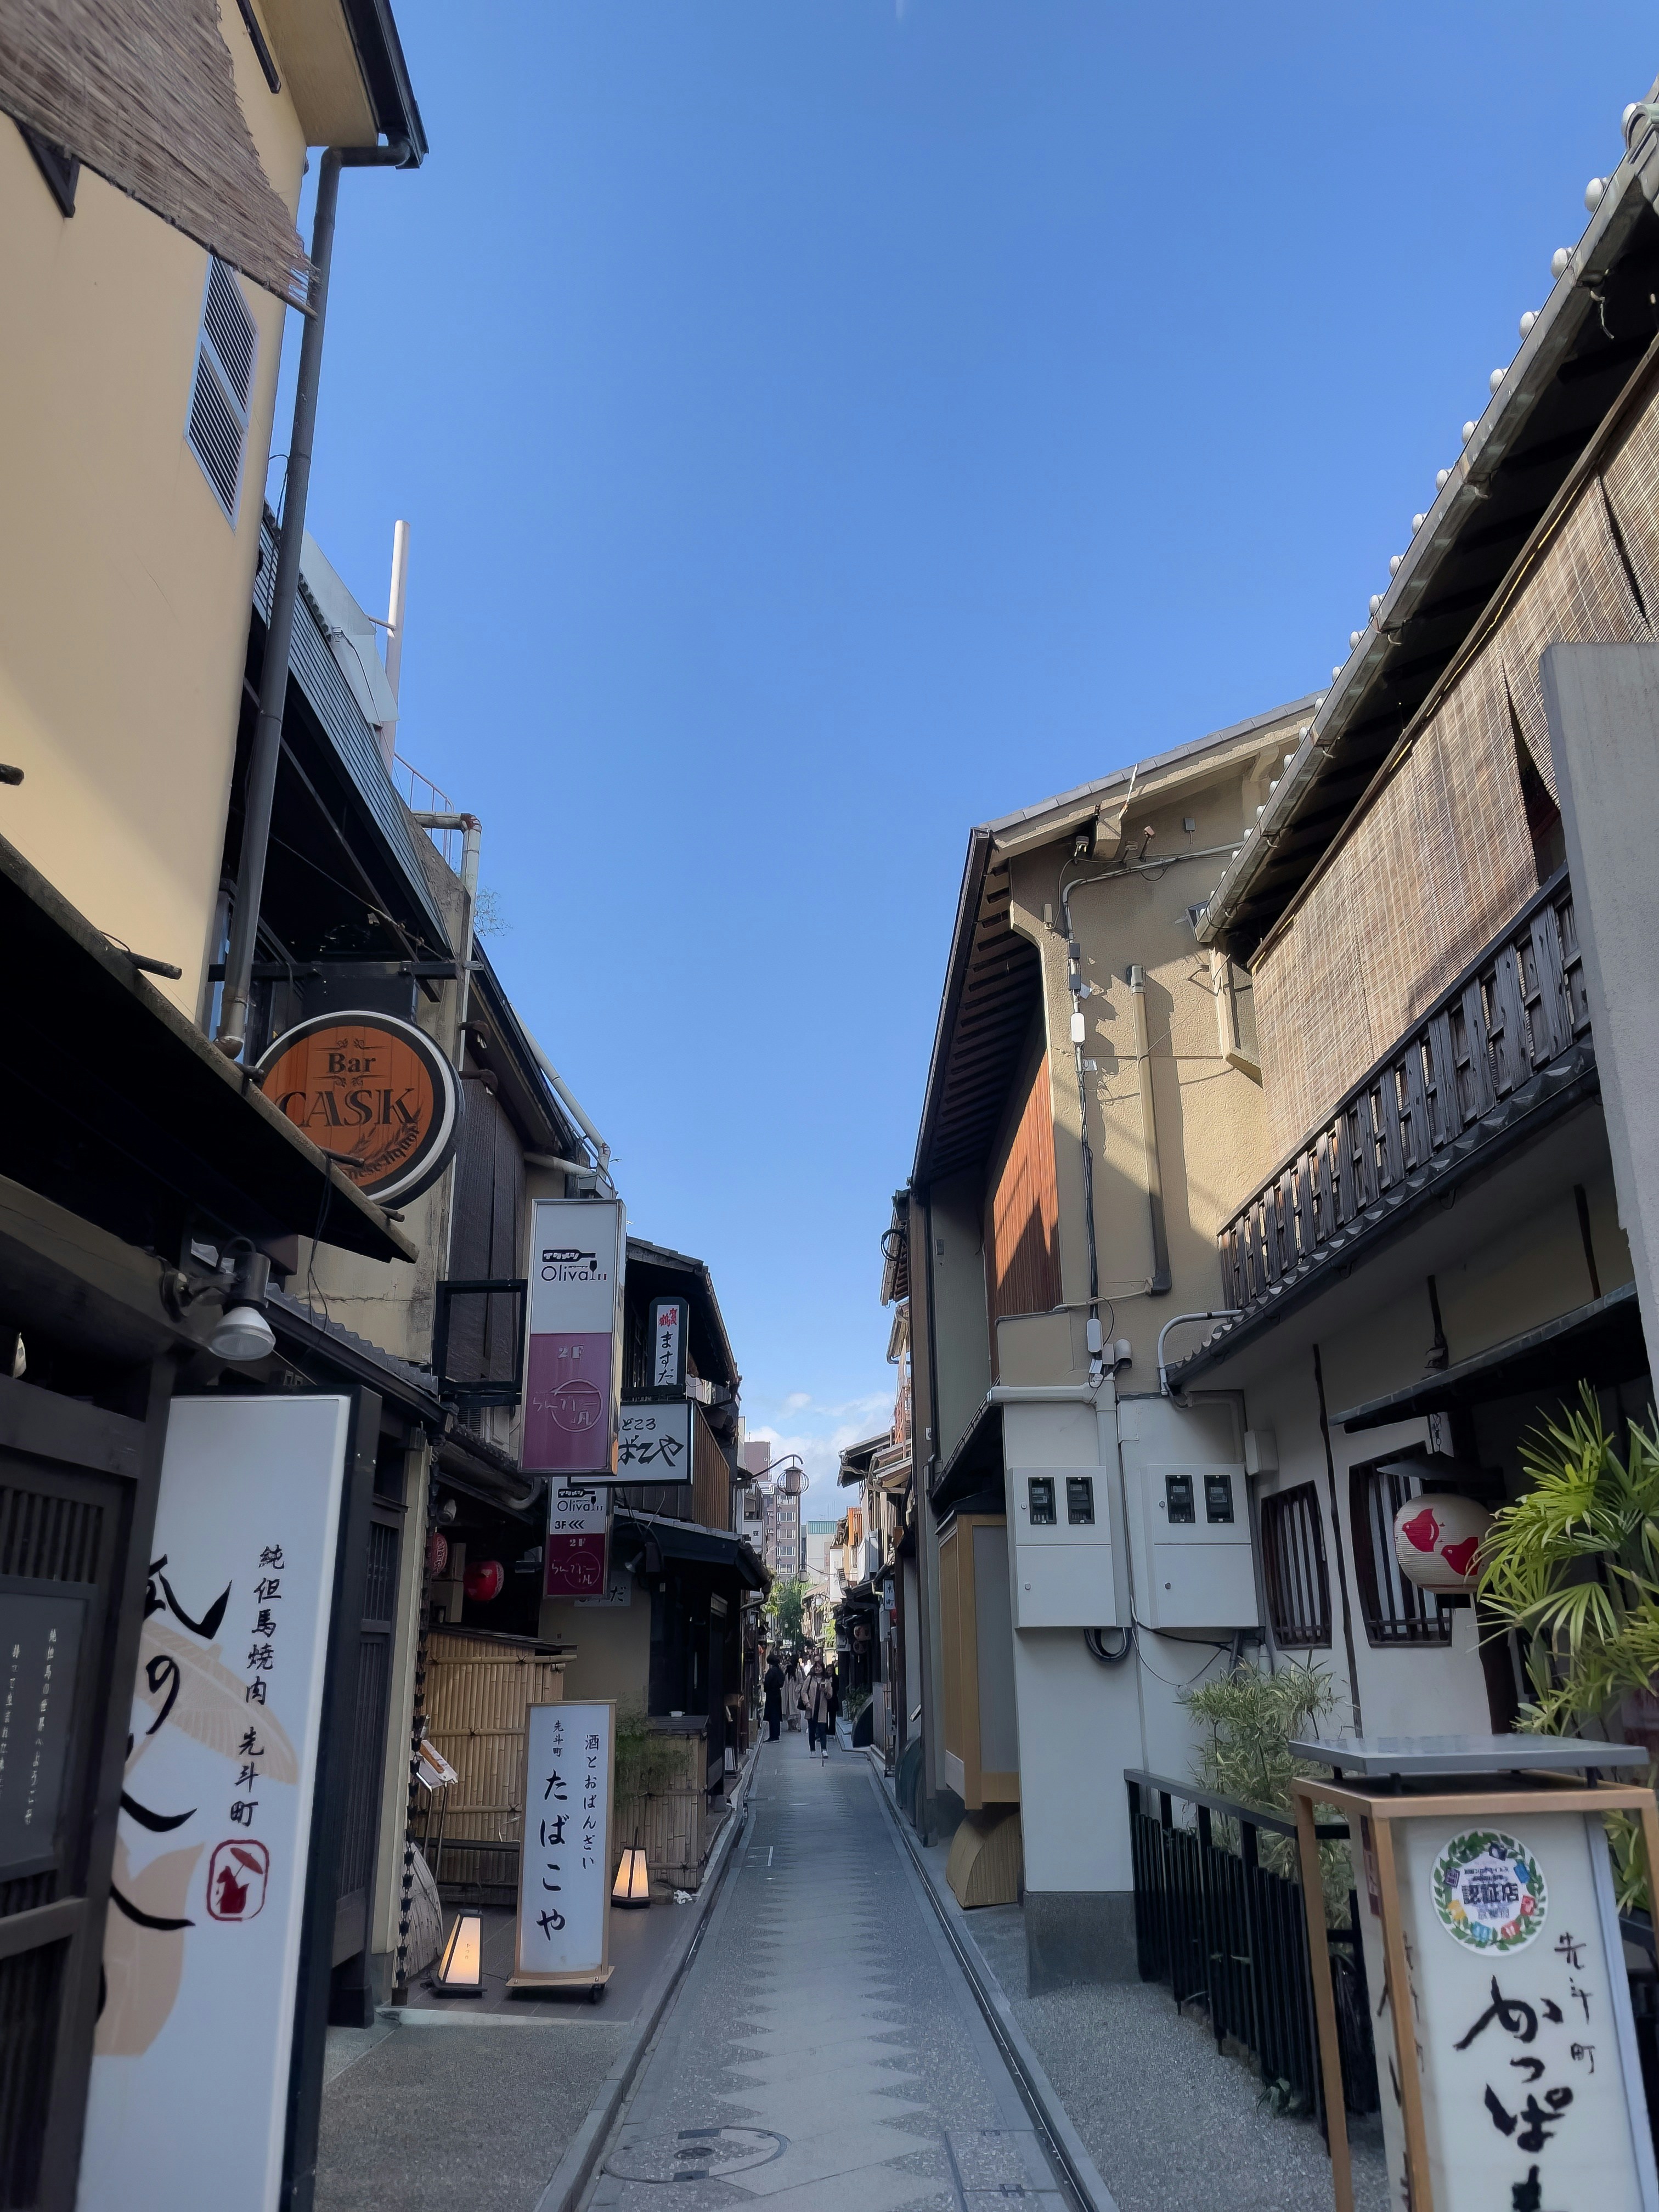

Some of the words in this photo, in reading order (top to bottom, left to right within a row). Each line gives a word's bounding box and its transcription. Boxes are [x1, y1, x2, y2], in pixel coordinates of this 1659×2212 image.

[328, 1052, 376, 1074] Bar
[275, 1088, 415, 1128] CASK
[557, 1344, 585, 1360] 2F
[658, 1330, 674, 1385] ますだ
[622, 1418, 656, 1431] どころ
[554, 1520, 567, 1530] 3F
[569, 1538, 586, 1547] 2F
[246, 1544, 285, 1705] 純但馬焼肉
[552, 1719, 565, 1758] 先斗町
[230, 1726, 265, 1827] 先斗町
[582, 1734, 600, 1870] 酒とおばんざい
[536, 1768, 571, 1942] たばこや
[1554, 1931, 1596, 2075] 先斗町
